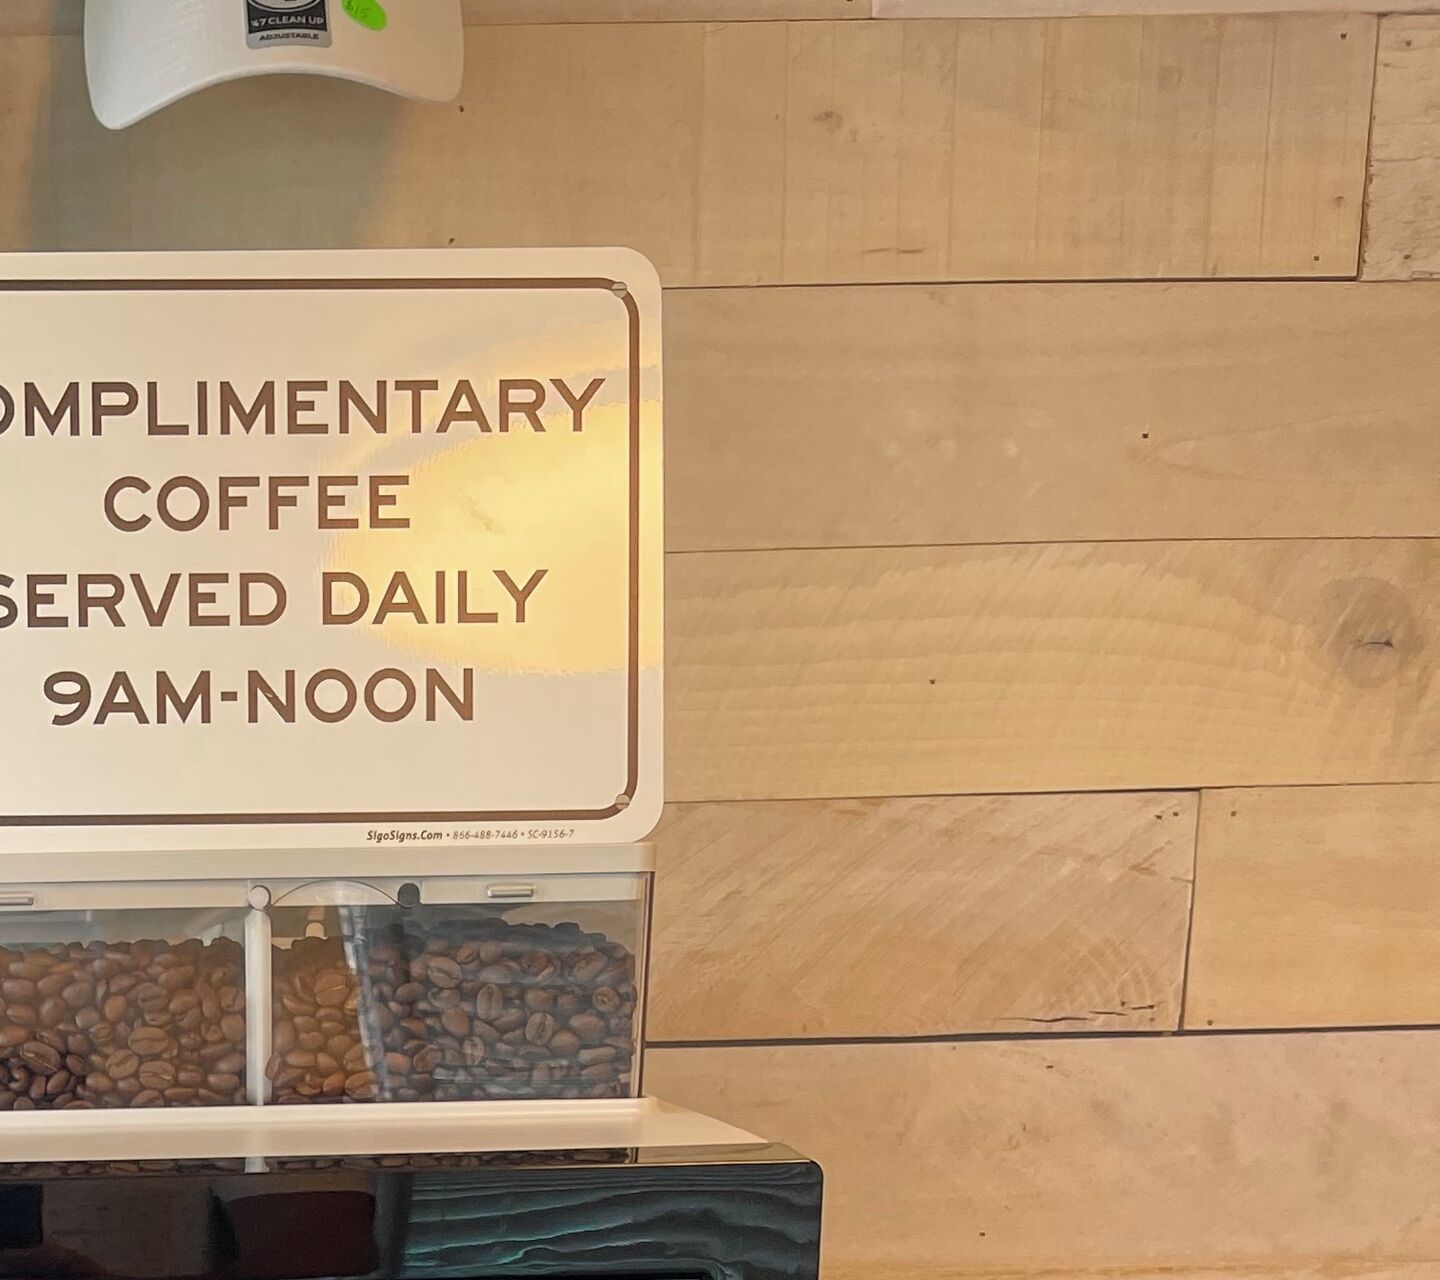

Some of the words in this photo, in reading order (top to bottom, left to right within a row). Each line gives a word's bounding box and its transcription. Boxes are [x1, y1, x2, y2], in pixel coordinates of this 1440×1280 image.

[268, 15, 306, 25] CLEAN
[308, 16, 324, 25] UP
[103, 474, 412, 532] COFFEE
[321, 568, 549, 625] DAILY
[43, 667, 476, 726] 9AM-NOON
